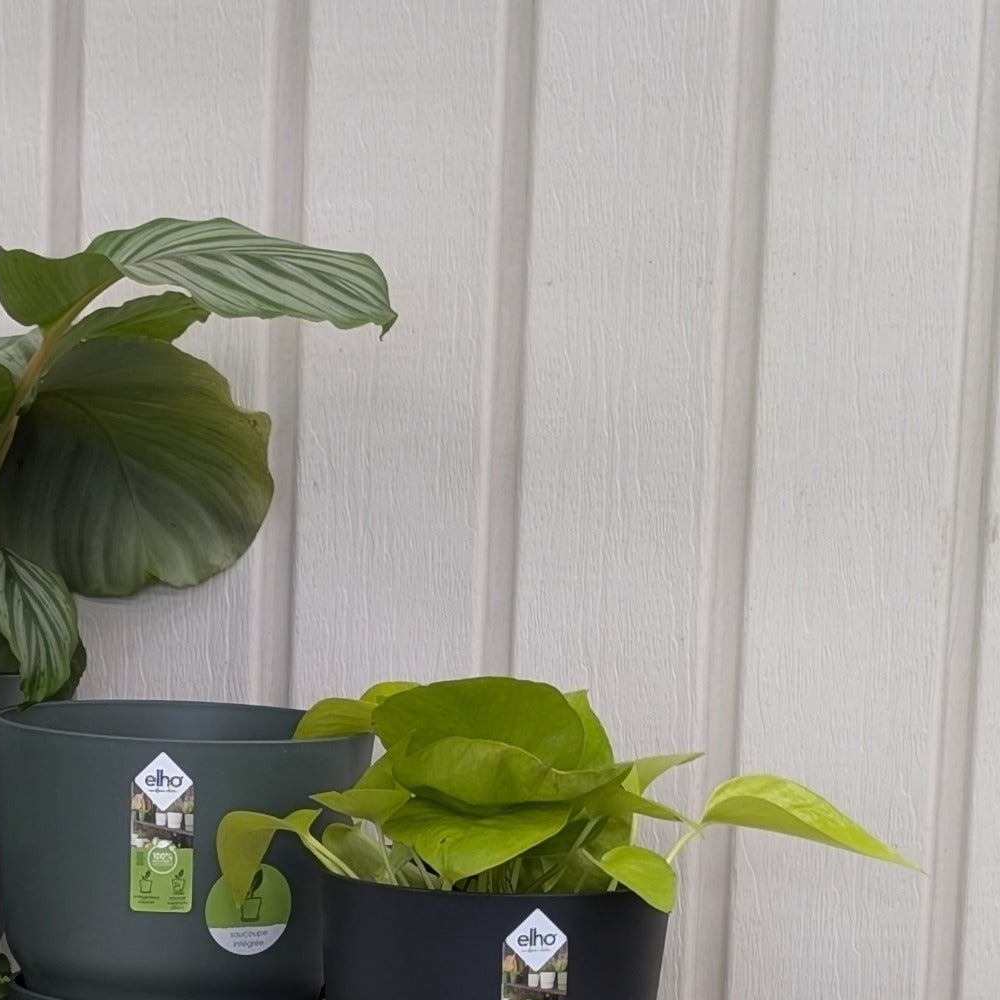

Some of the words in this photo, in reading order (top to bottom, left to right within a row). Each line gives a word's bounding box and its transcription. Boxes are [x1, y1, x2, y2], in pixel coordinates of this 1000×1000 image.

[145, 769, 184, 787] elho
[152, 852, 173, 861] 100%
[517, 928, 557, 947] elho
